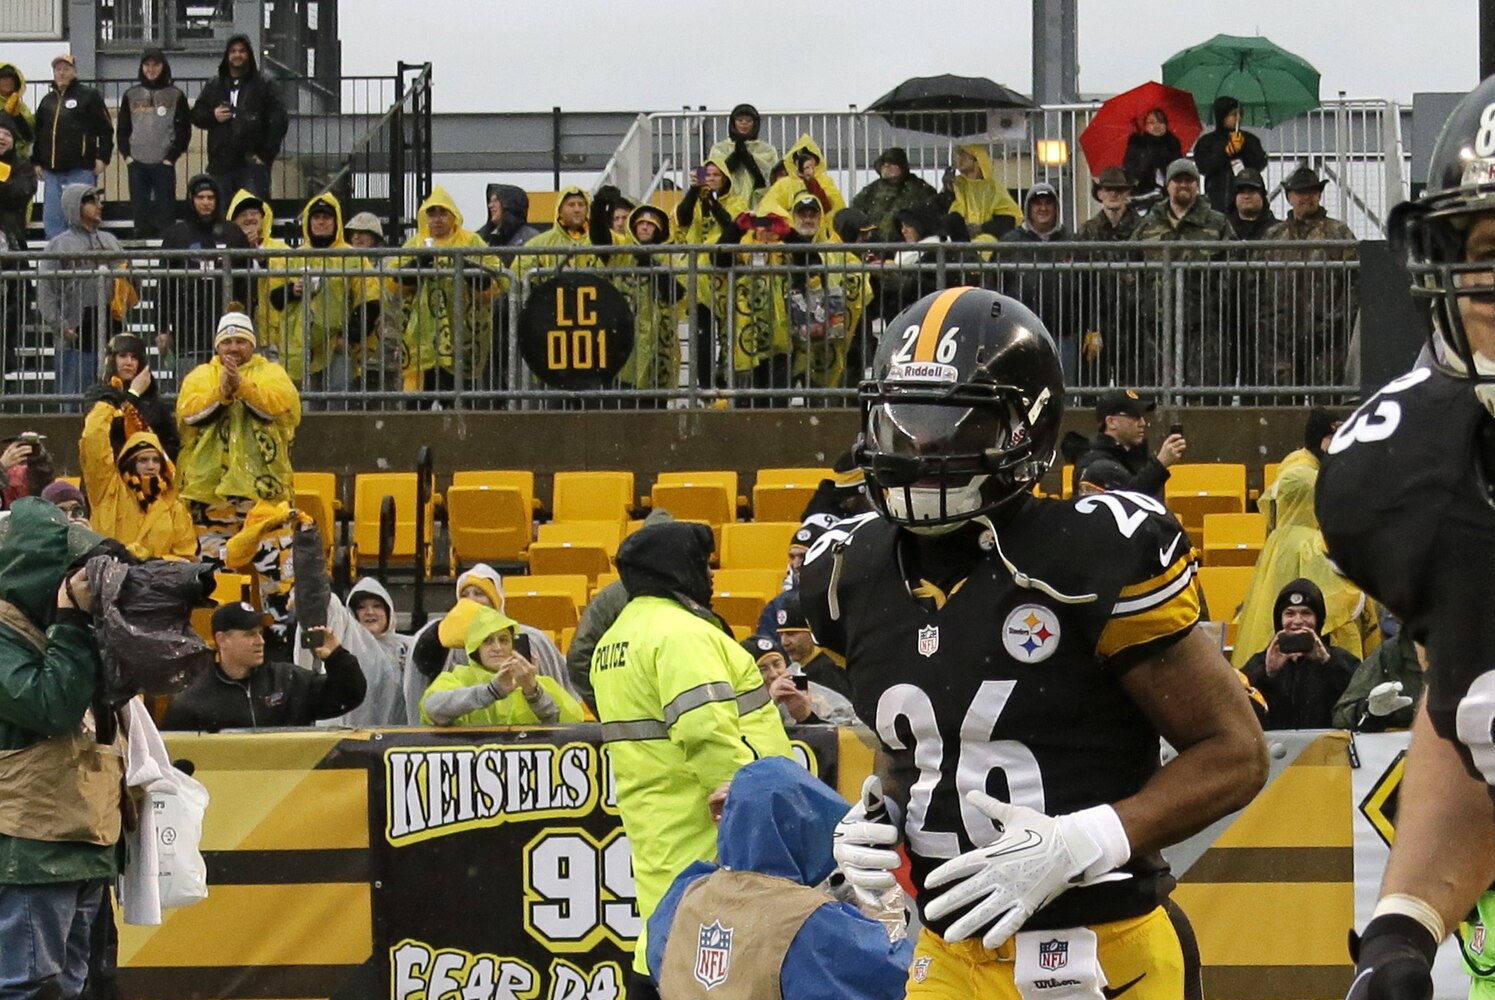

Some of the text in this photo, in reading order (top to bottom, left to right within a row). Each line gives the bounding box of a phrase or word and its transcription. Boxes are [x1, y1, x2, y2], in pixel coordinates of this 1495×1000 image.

[556, 286, 597, 326] LC
[547, 329, 606, 369] 001
[904, 366, 942, 378] Riddell
[595, 641, 629, 673] POLICE
[920, 638, 936, 651] NFL
[876, 680, 1045, 858] 26
[390, 748, 590, 838] KEISELS
[699, 949, 726, 980] NFL
[1042, 952, 1066, 968] NFL
[1033, 978, 1082, 989] Wilson
